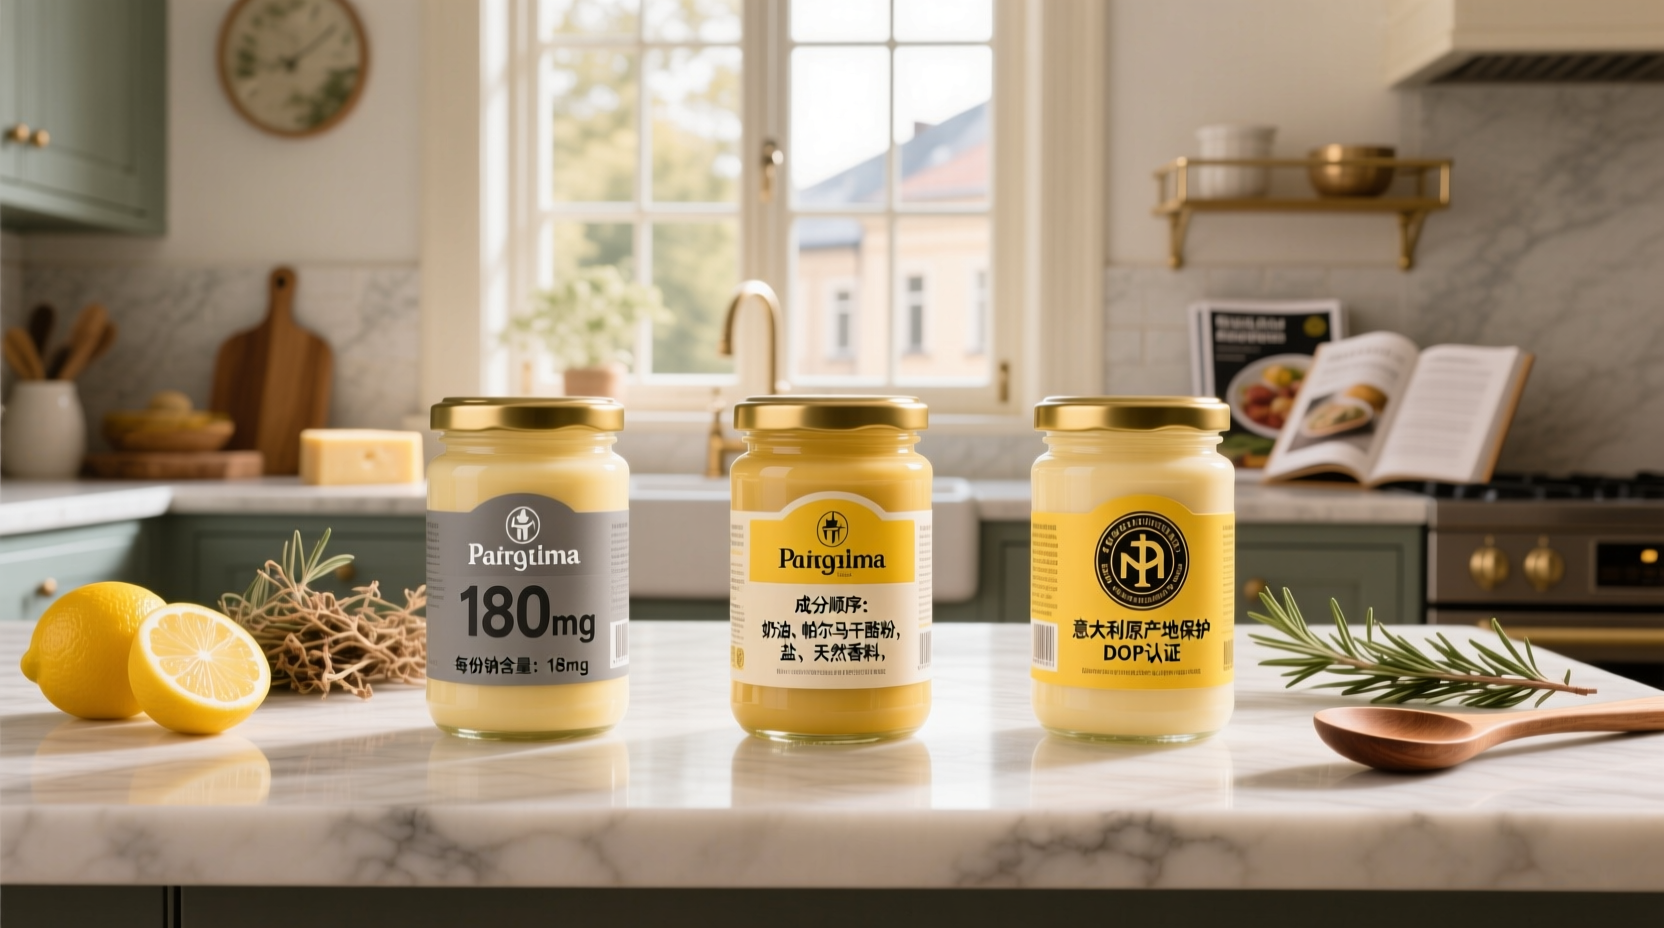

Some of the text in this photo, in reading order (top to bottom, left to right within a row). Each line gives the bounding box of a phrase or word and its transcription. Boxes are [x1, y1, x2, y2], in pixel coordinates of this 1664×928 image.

[1072, 617, 1211, 641] 意大利原产地保护
